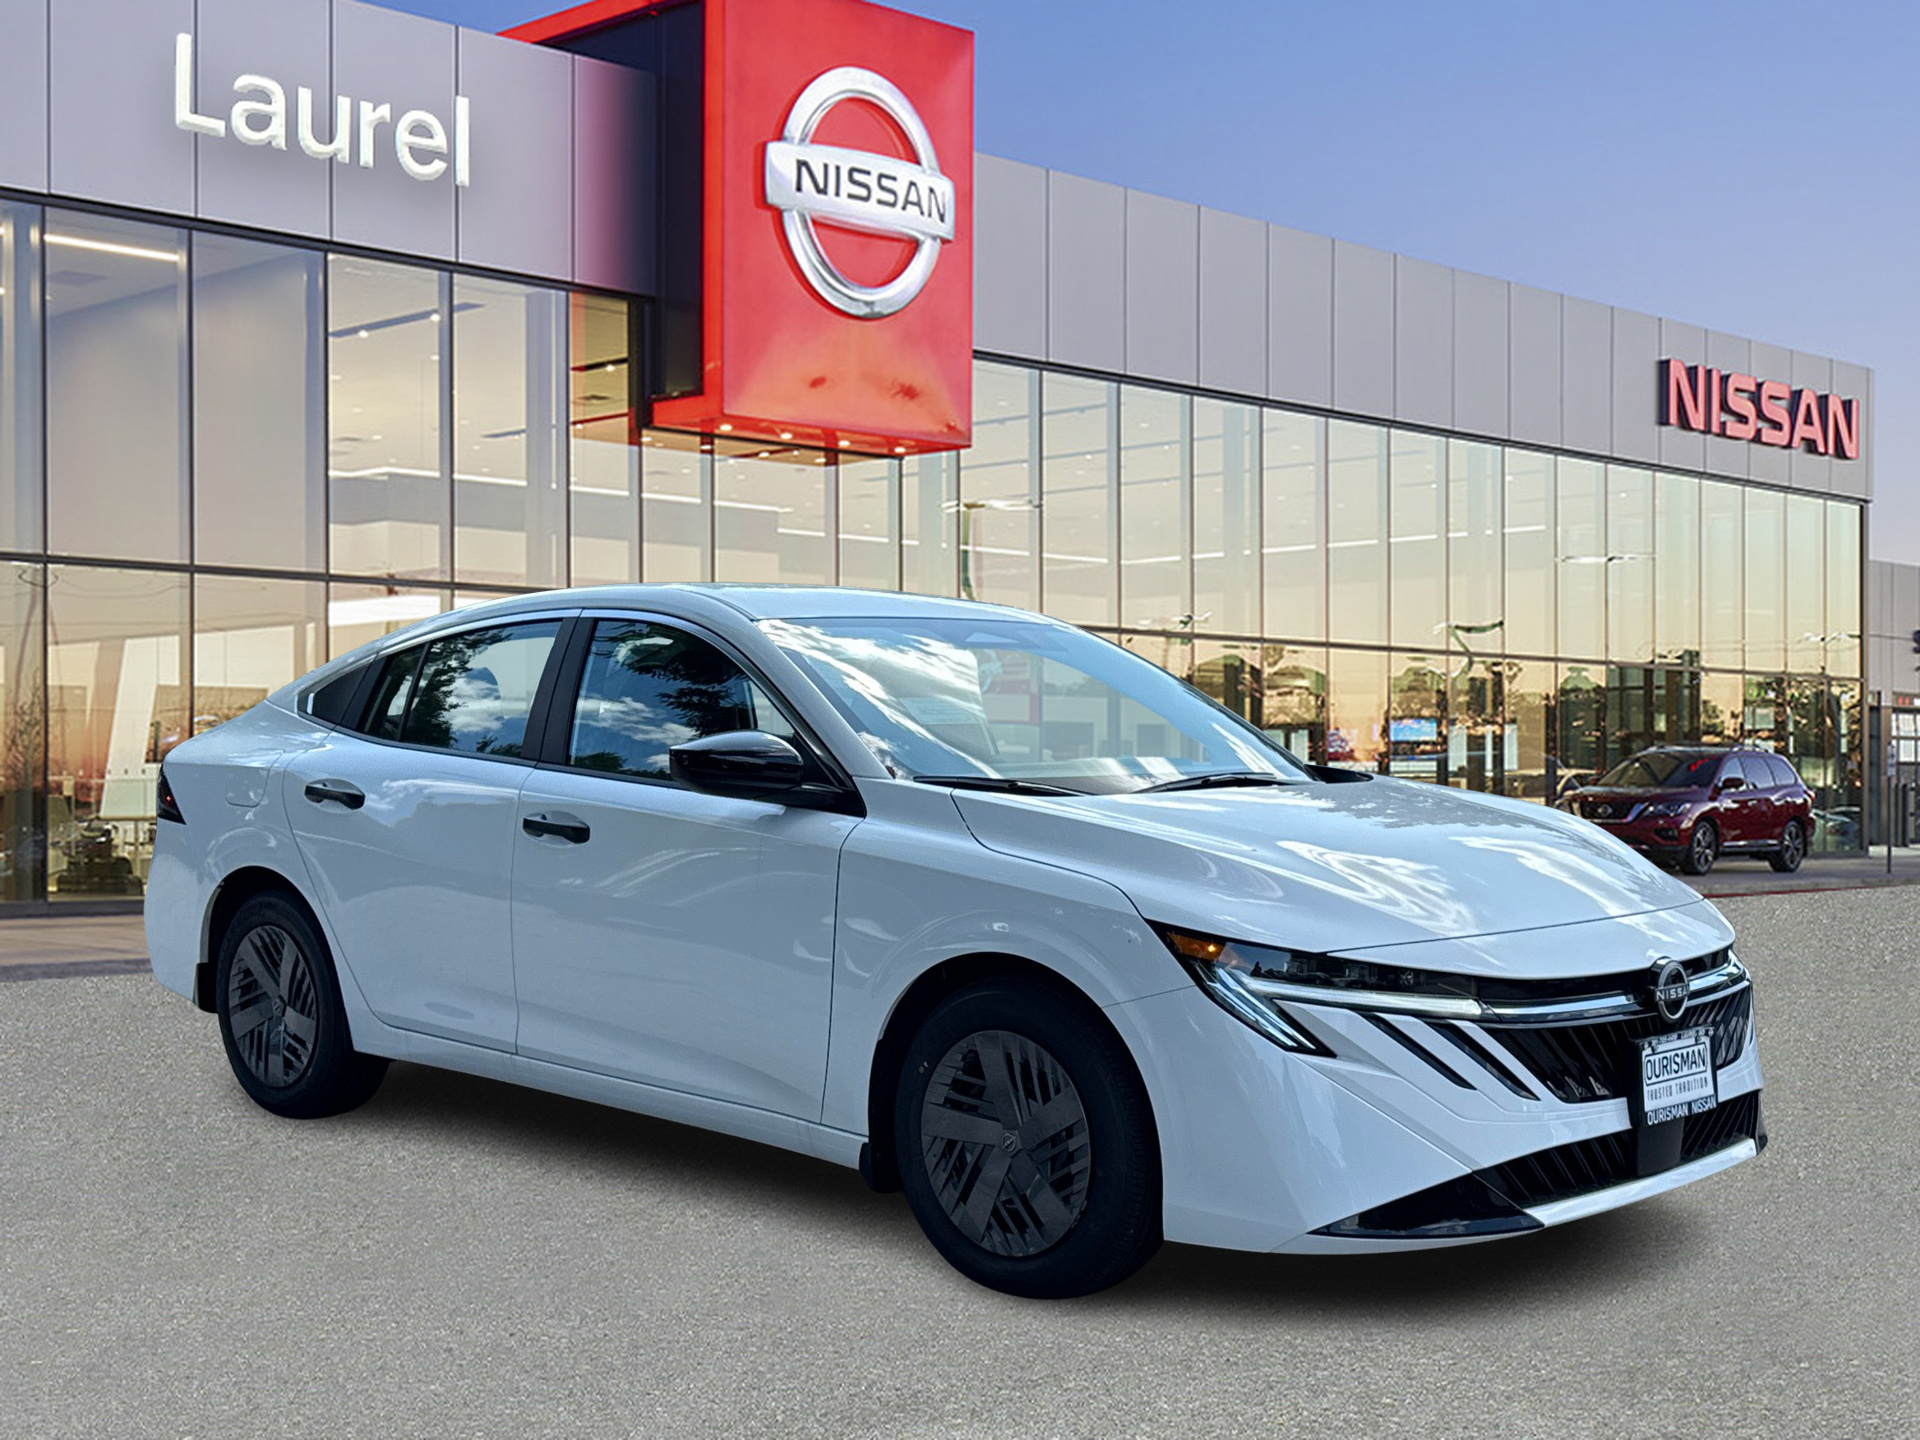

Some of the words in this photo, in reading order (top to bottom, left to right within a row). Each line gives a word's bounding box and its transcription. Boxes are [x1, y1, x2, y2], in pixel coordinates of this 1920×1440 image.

[175, 32, 470, 188] Laurel
[794, 158, 946, 224] NISSAN
[1659, 358, 1860, 460] NISSAN
[1655, 985, 1689, 1002] NISSA
[1645, 1047, 1706, 1081] OURISMAN
[1647, 1084, 1673, 1102] TRUSTED
[1674, 1076, 1708, 1096] TRADITION
[1647, 1102, 1689, 1126] OURISMAN
[1691, 1095, 1717, 1115] NISSAN
